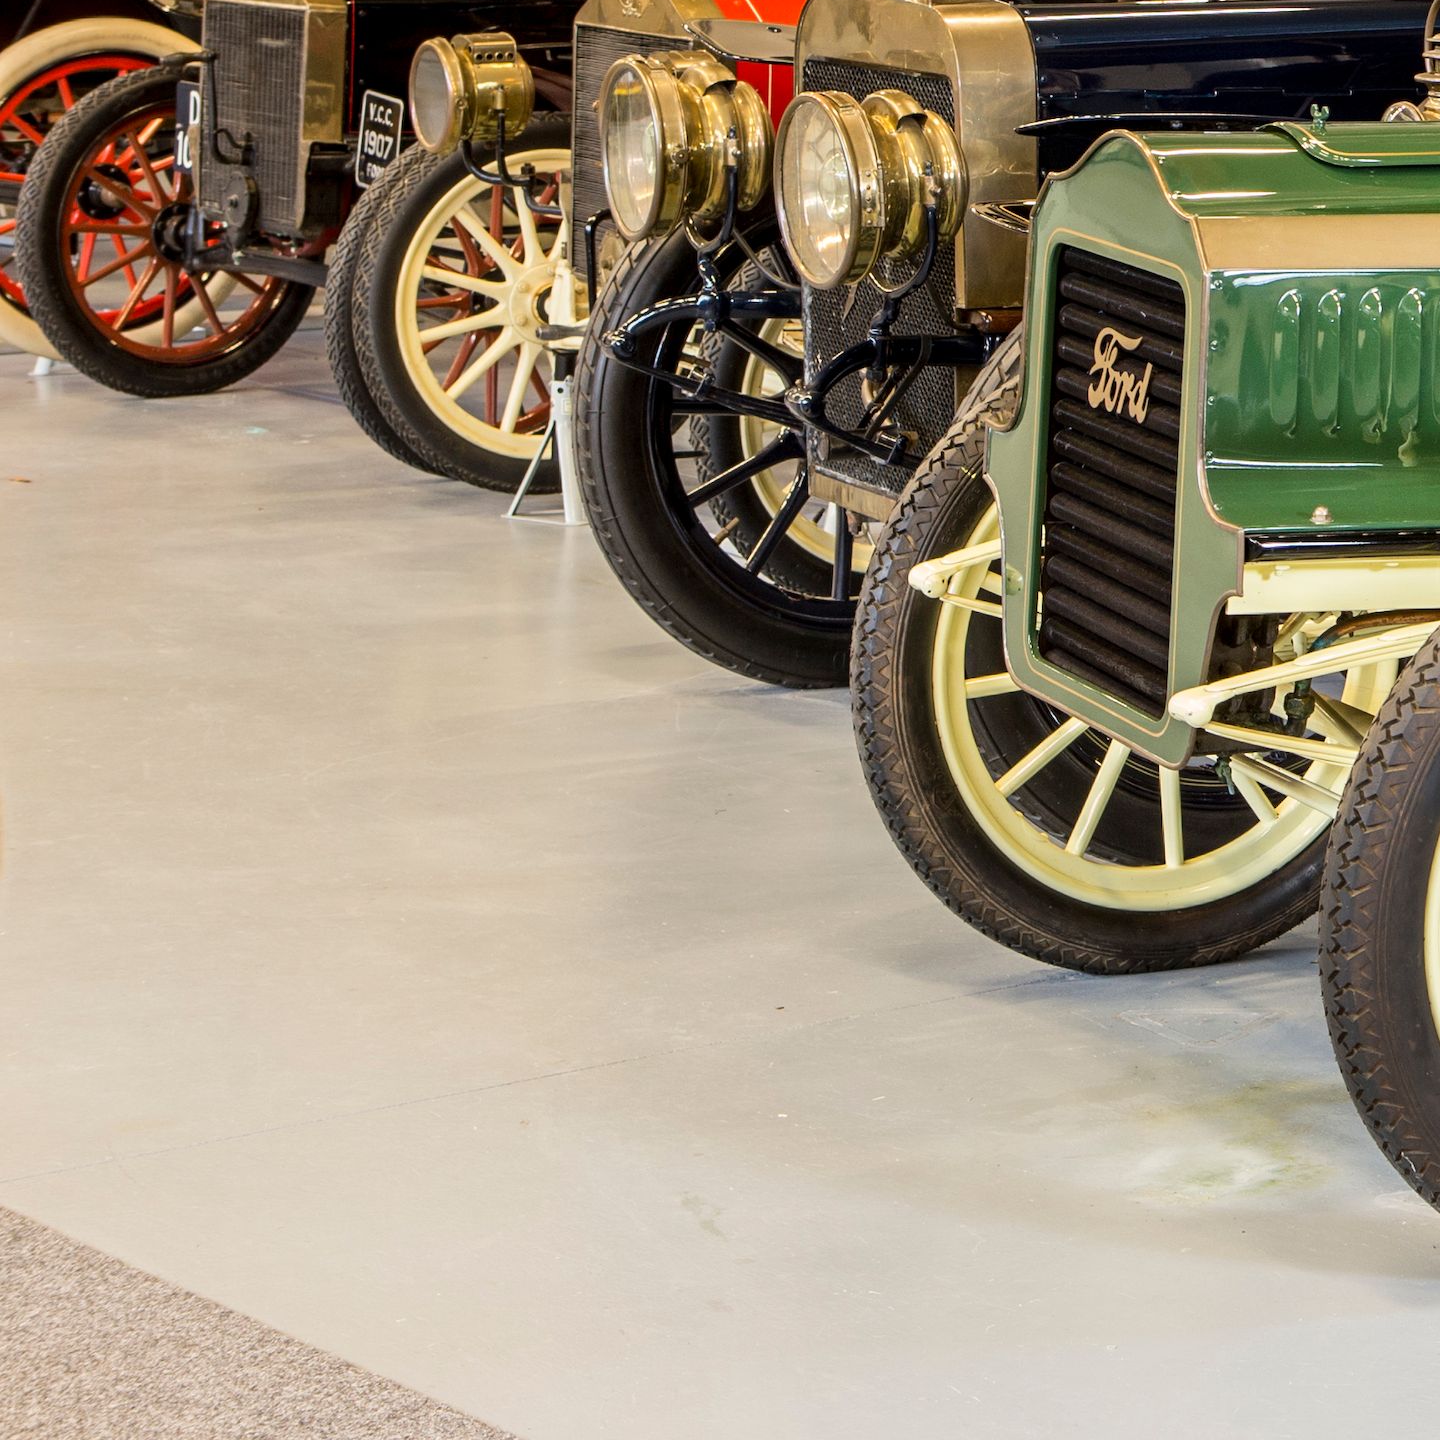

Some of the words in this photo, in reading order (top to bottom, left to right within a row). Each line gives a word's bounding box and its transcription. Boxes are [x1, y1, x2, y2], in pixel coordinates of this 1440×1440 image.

[369, 102, 394, 128] V.C.C.
[363, 129, 394, 160] 1907
[1088, 327, 1153, 424] Ford
